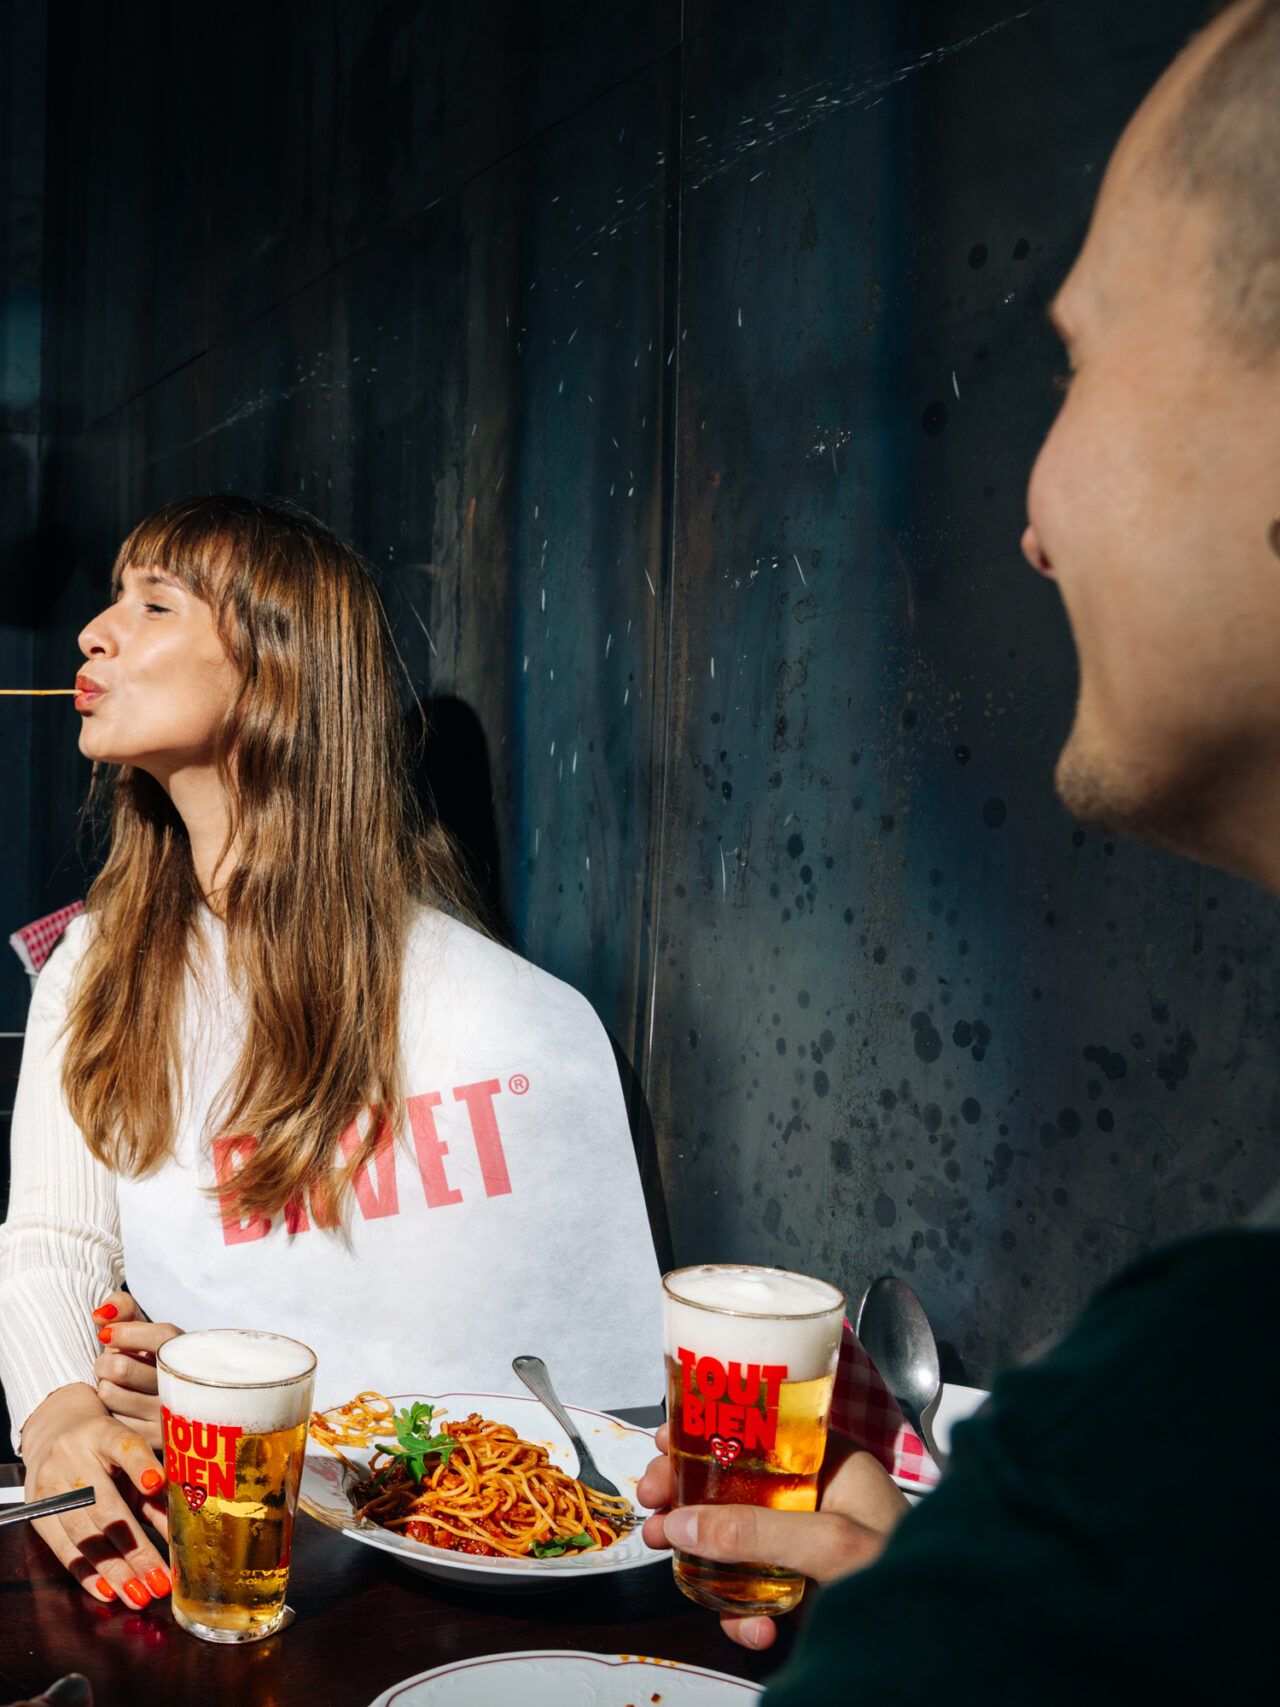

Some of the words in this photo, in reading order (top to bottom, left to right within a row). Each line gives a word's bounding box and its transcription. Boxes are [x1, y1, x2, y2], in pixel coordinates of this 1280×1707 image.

[677, 1346, 788, 1409] TOUT
[161, 1403, 243, 1463] TOUT
[682, 1391, 779, 1451] BIEN
[165, 1442, 237, 1500] BIEN
